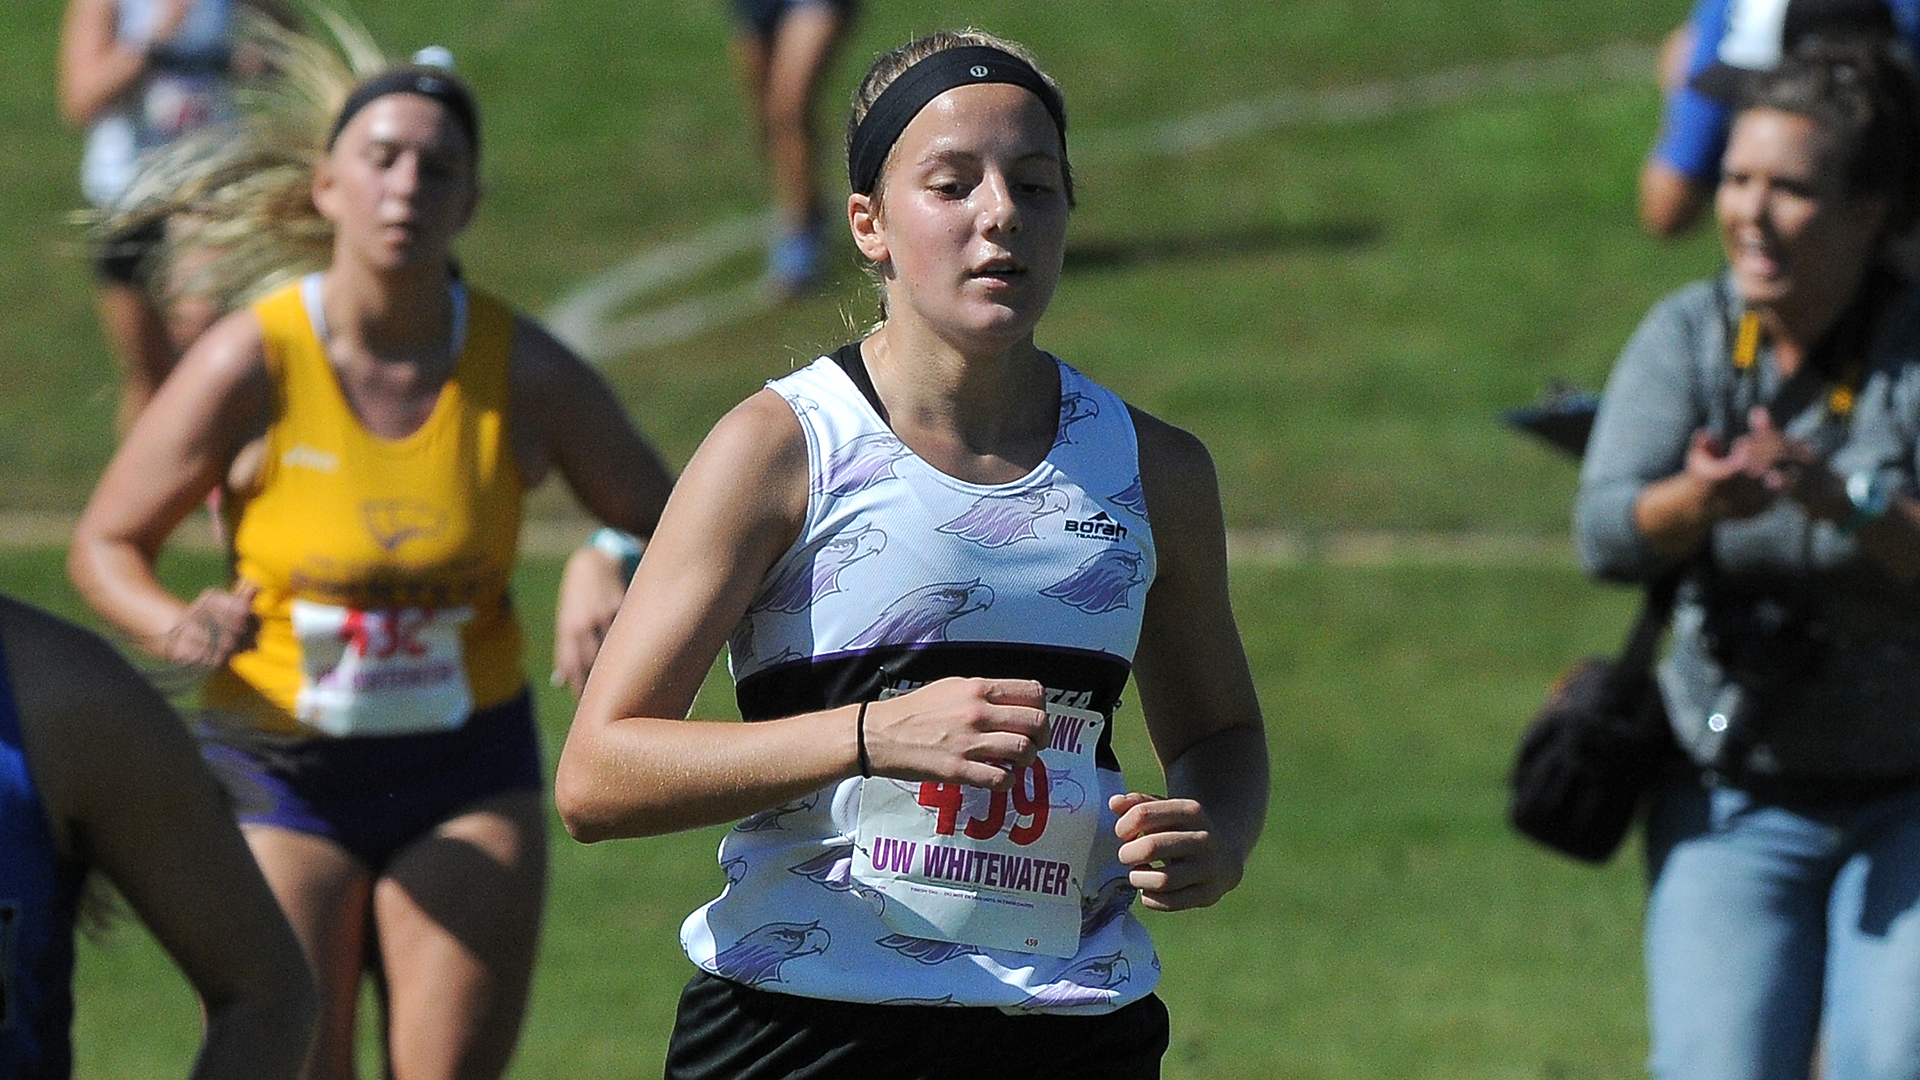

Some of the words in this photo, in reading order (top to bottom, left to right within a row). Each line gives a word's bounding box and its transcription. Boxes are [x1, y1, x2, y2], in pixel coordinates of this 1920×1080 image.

[872, 837, 917, 875] UW
[923, 844, 1071, 897] WHITEWATER
[1025, 938, 1039, 947] 459
